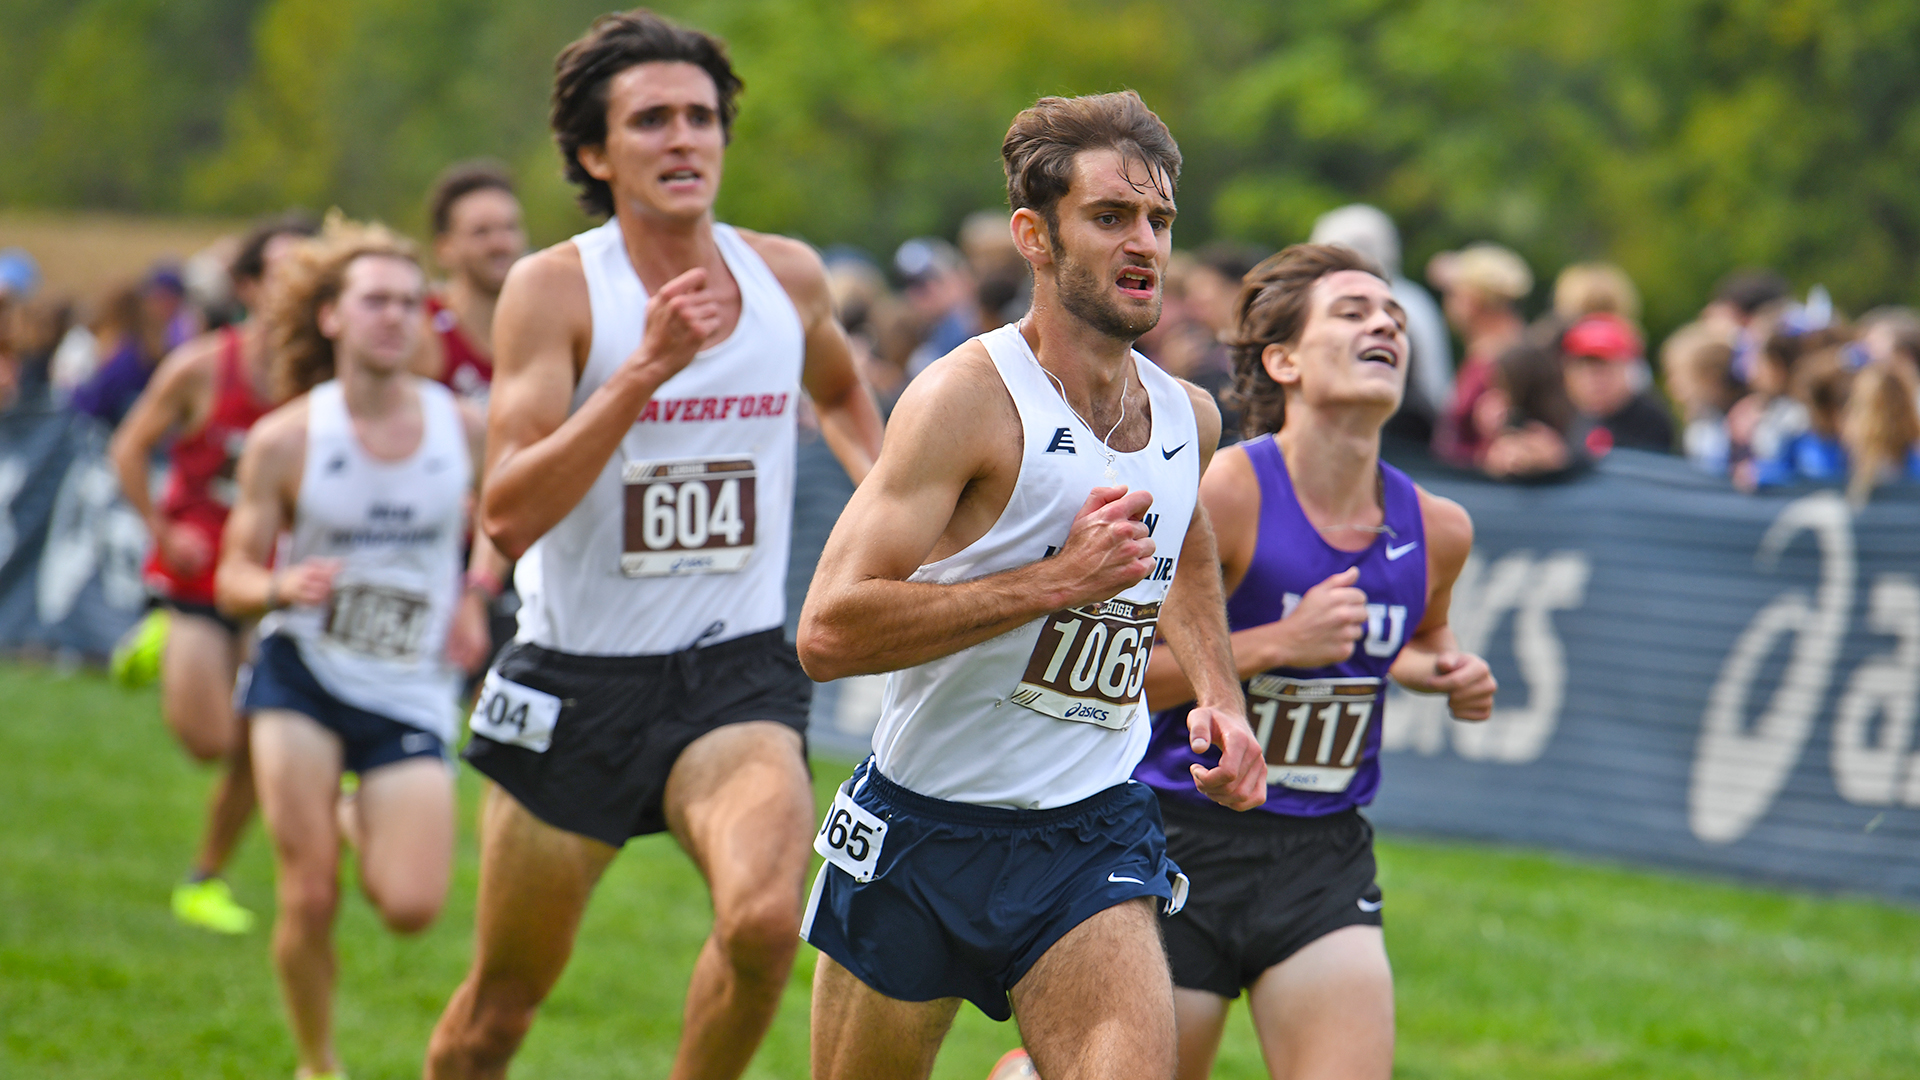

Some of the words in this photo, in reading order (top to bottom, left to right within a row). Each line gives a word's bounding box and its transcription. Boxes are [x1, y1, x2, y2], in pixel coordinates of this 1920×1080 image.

[635, 393, 788, 423] AVERFORD
[643, 479, 745, 550] 604
[1100, 602, 1134, 618] HIGH
[1042, 618, 1154, 698] 1065
[1252, 700, 1374, 766] 1117
[822, 802, 873, 862] 65
